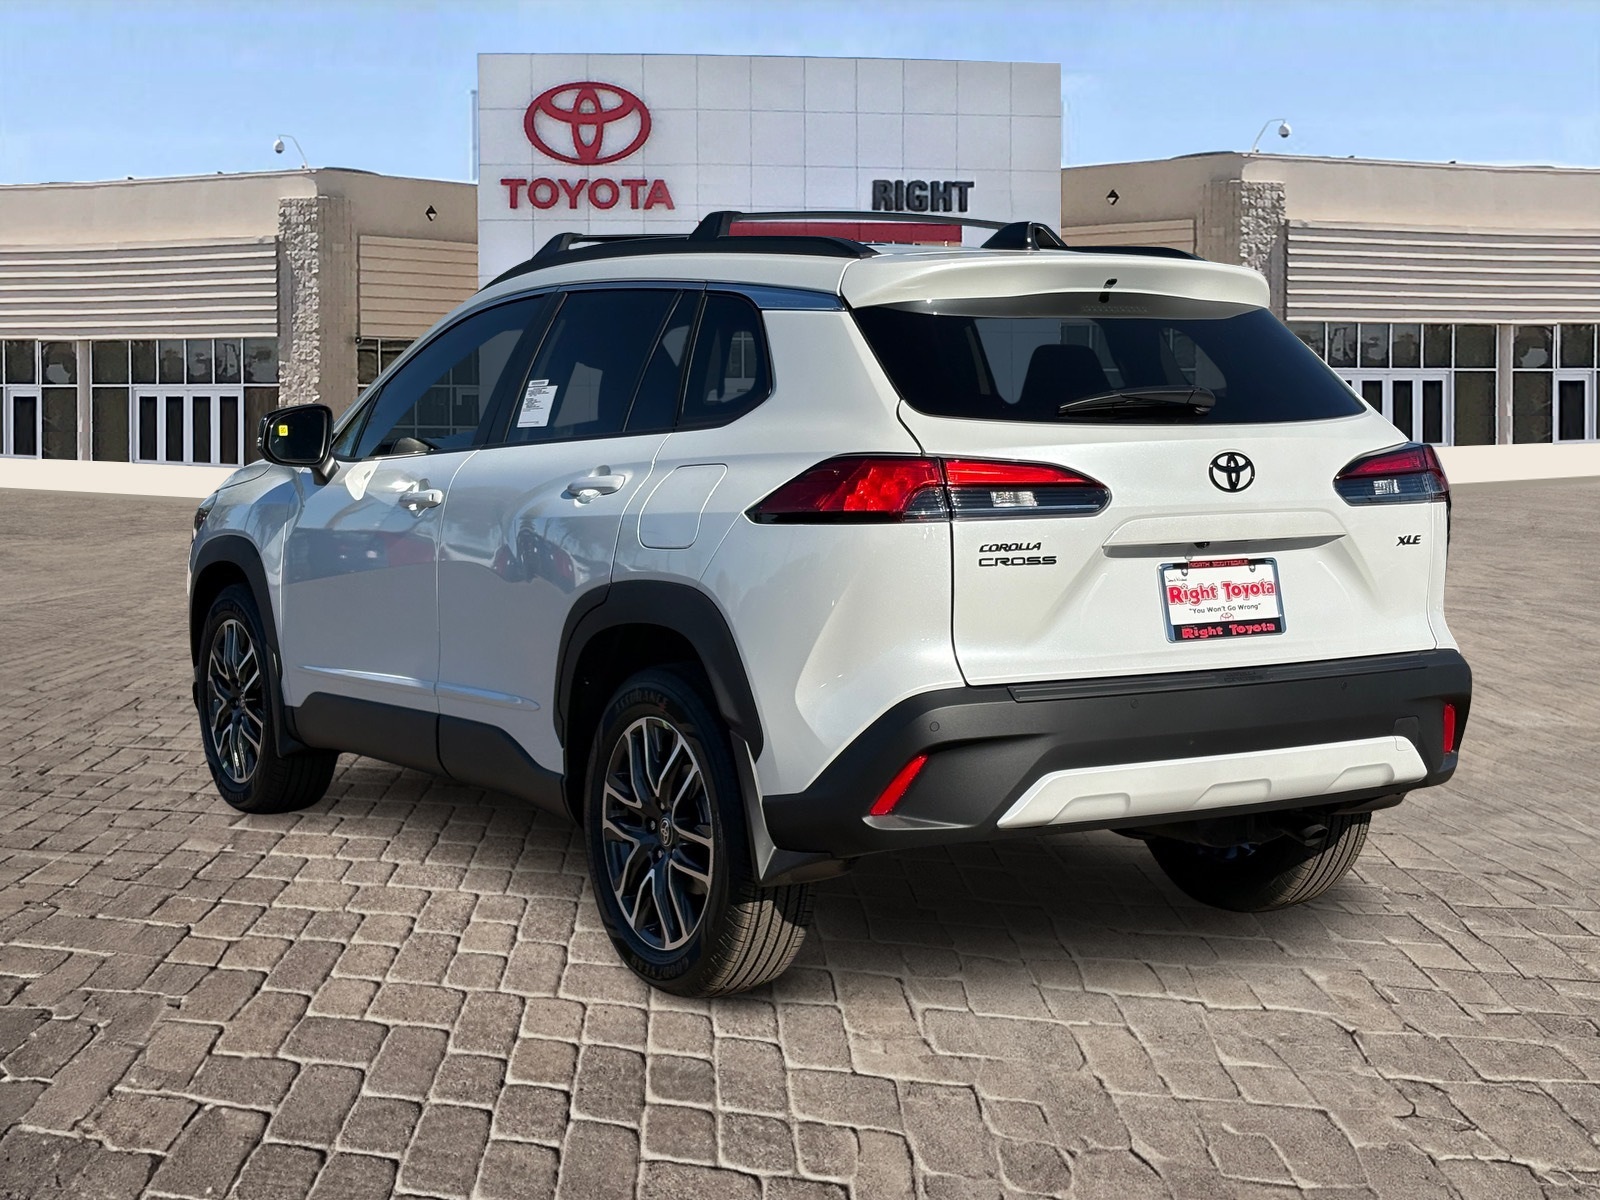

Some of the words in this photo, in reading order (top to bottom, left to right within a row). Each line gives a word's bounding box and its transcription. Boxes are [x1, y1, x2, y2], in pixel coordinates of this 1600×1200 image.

[501, 178, 675, 210] TOYOTA
[872, 179, 975, 212] RIGHT
[979, 542, 1041, 552] COROLLA
[1396, 534, 1422, 546] XLE
[979, 556, 1057, 567] CROSS
[1167, 583, 1218, 606] Right
[1221, 579, 1276, 602] Toyota
[1207, 605, 1226, 613] Won't
[1182, 627, 1223, 639] Right
[1229, 623, 1275, 636] Toyota
